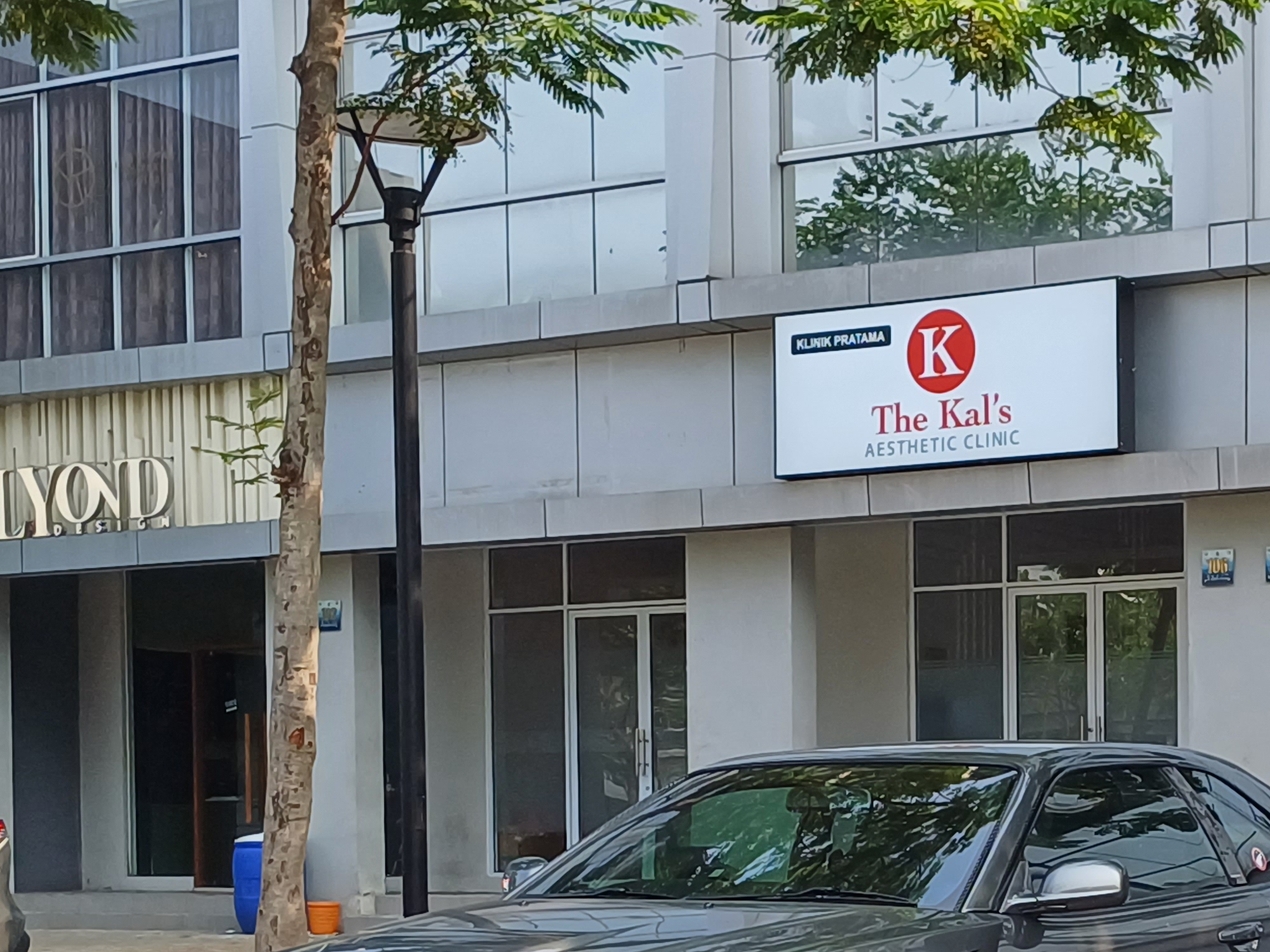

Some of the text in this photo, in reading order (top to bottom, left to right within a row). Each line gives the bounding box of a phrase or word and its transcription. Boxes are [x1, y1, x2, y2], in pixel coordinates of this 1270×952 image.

[796, 331, 886, 351] KLINIK PRATAMA
[917, 324, 965, 379] K
[871, 393, 1012, 435] The Kal's
[864, 430, 1021, 458] AESTHETIC CLINIC
[53, 515, 170, 536] DESIGN
